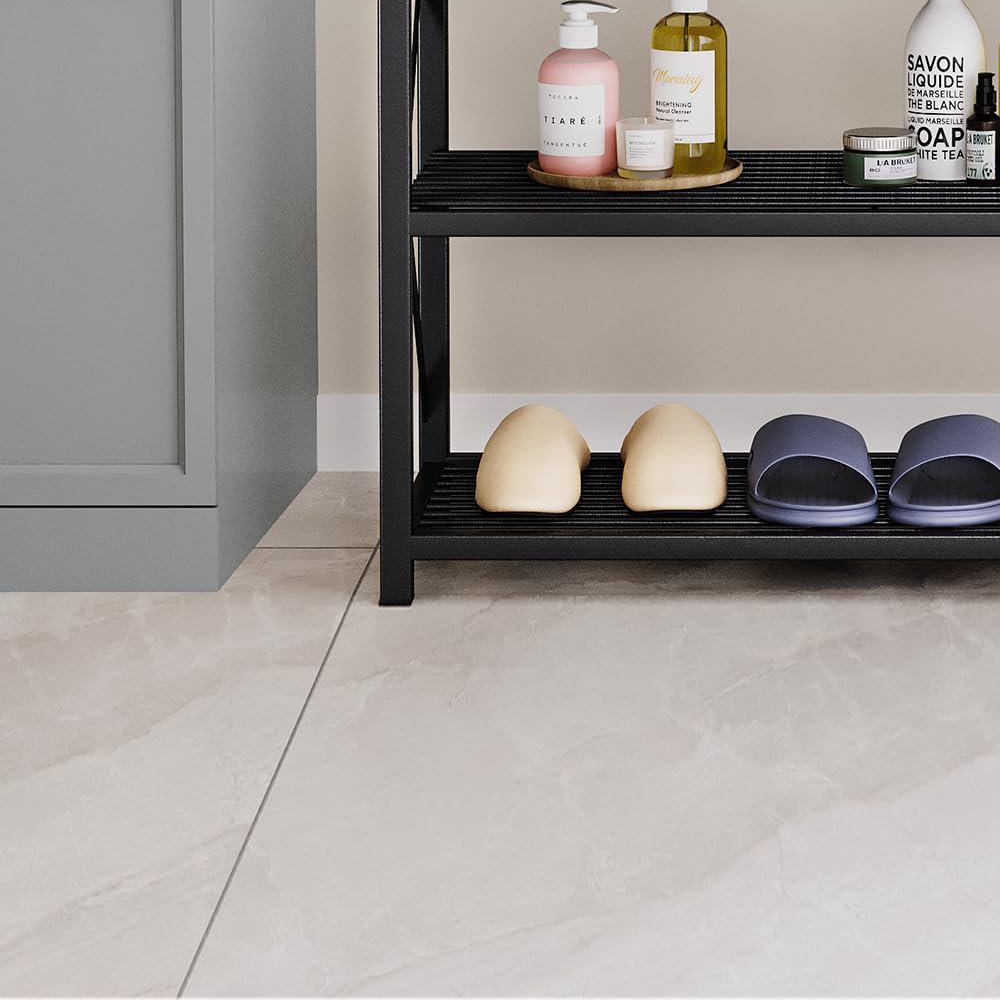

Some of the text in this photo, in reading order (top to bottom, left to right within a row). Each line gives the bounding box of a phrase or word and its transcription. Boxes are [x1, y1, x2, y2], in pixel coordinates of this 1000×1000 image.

[907, 54, 964, 72] SAVON
[652, 67, 704, 93] Morning
[907, 73, 964, 88] LIQUIDE
[907, 88, 964, 98] DE MARSEILLE
[656, 100, 692, 108] BRIGHTENING
[908, 98, 964, 111] THE BLANC
[544, 115, 586, 125] TIARÉ
[925, 117, 964, 125] MARSEILLE
[973, 134, 993, 145] BRUKET
[942, 150, 965, 160] TEA
[891, 156, 916, 166] BRUKET
